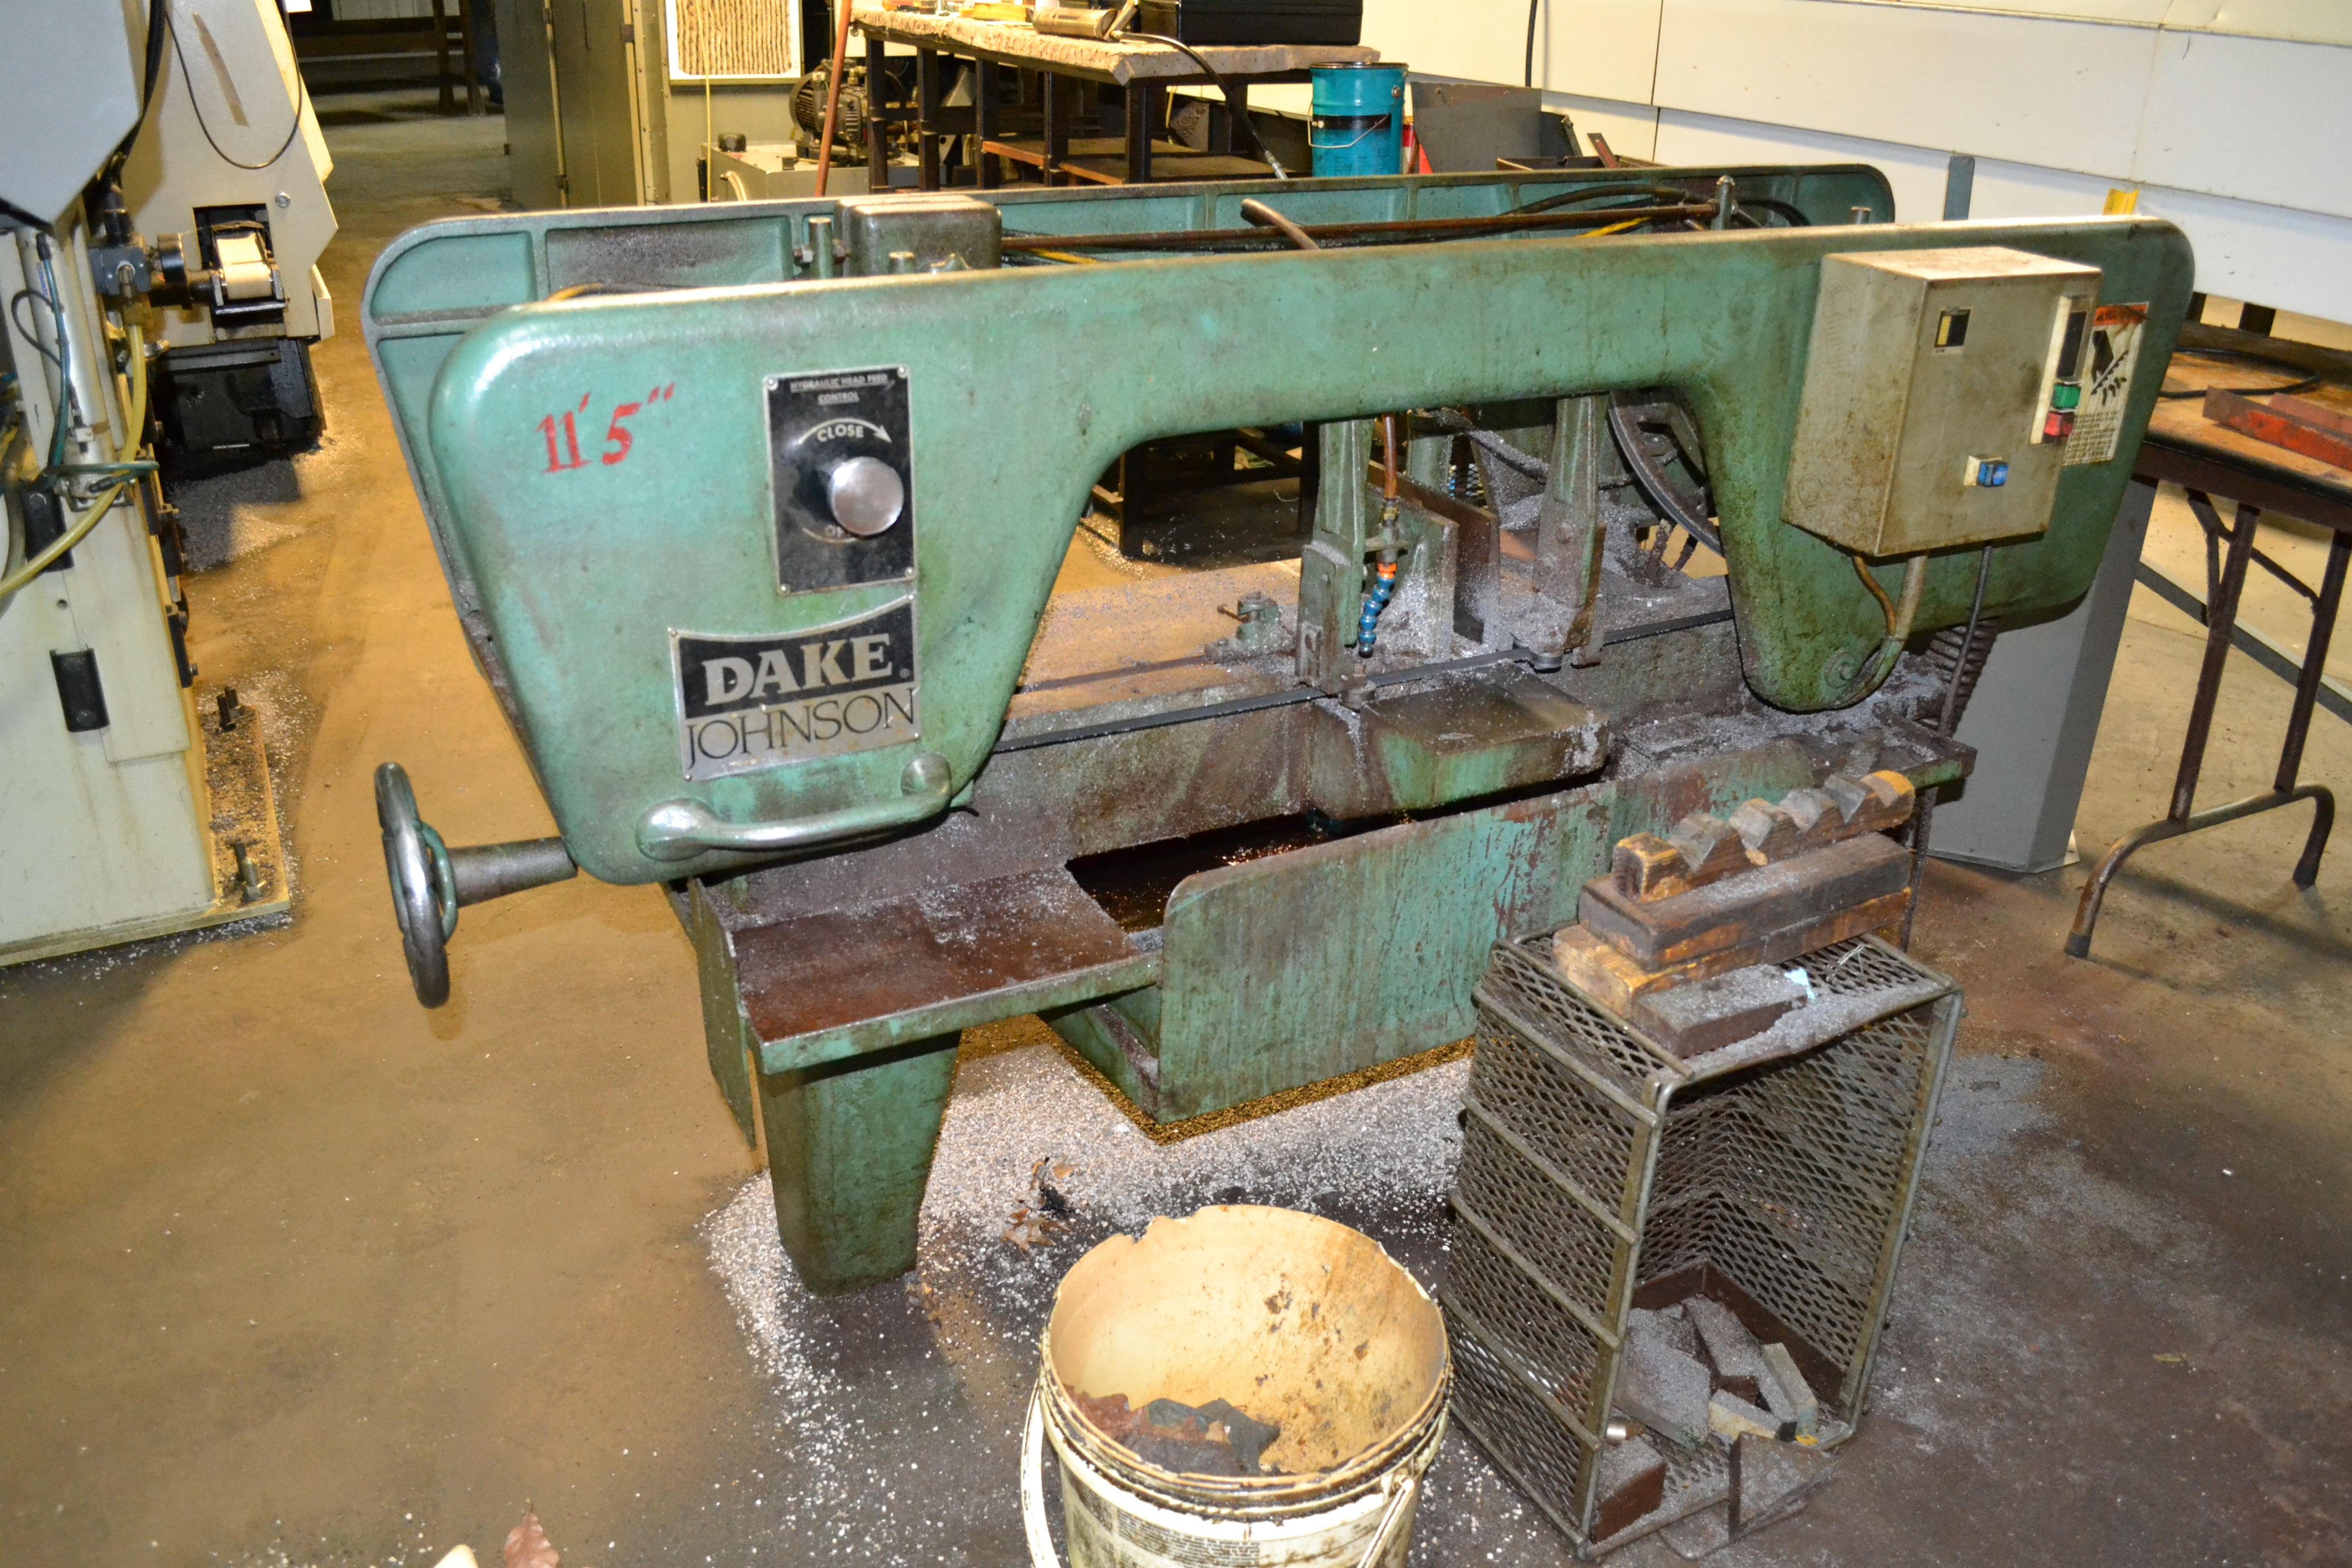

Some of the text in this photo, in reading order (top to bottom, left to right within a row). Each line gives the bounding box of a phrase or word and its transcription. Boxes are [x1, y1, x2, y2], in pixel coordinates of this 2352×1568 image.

[791, 373, 888, 390] HYDRAULIC HEAD FEED
[818, 391, 860, 402] CONTROL
[817, 424, 865, 442] CLOSE
[701, 633, 893, 706] DAKE
[686, 687, 917, 769] JOHNSON
